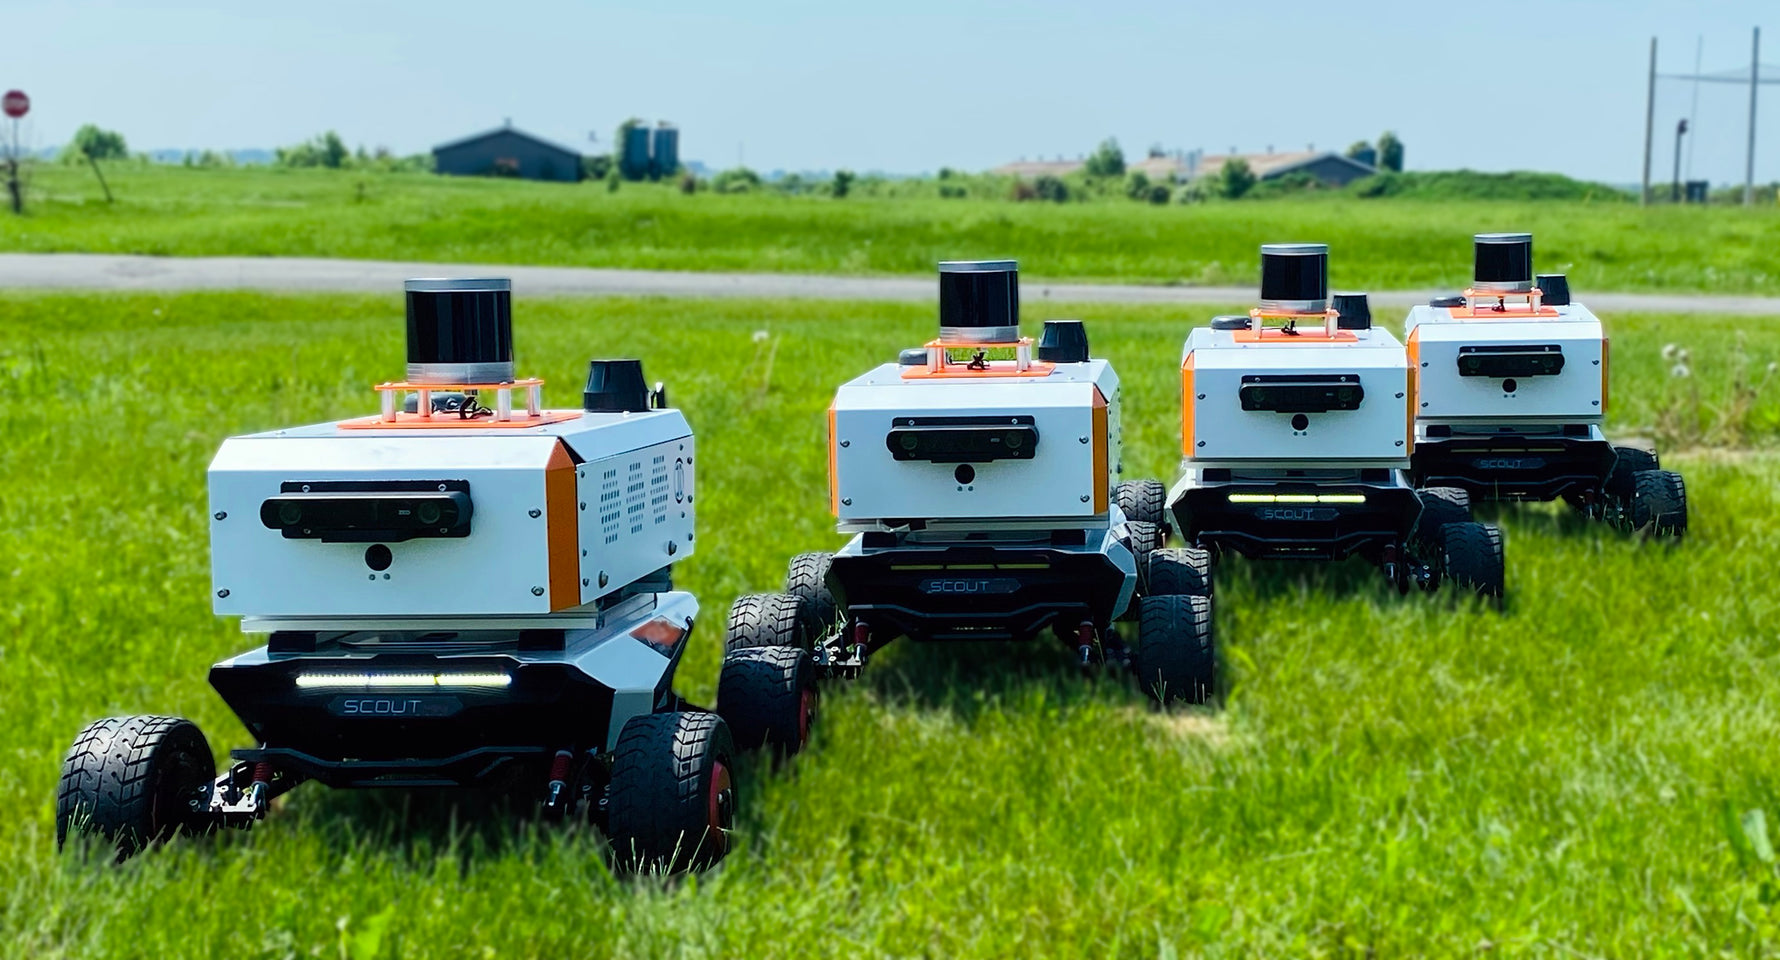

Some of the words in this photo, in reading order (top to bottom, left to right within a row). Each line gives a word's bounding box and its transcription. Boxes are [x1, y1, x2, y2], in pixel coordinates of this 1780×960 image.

[1480, 460, 1522, 469] SCOUT
[1264, 509, 1313, 520] SCOUT
[930, 581, 990, 592] SCOUT
[344, 700, 421, 713] SCOUT
